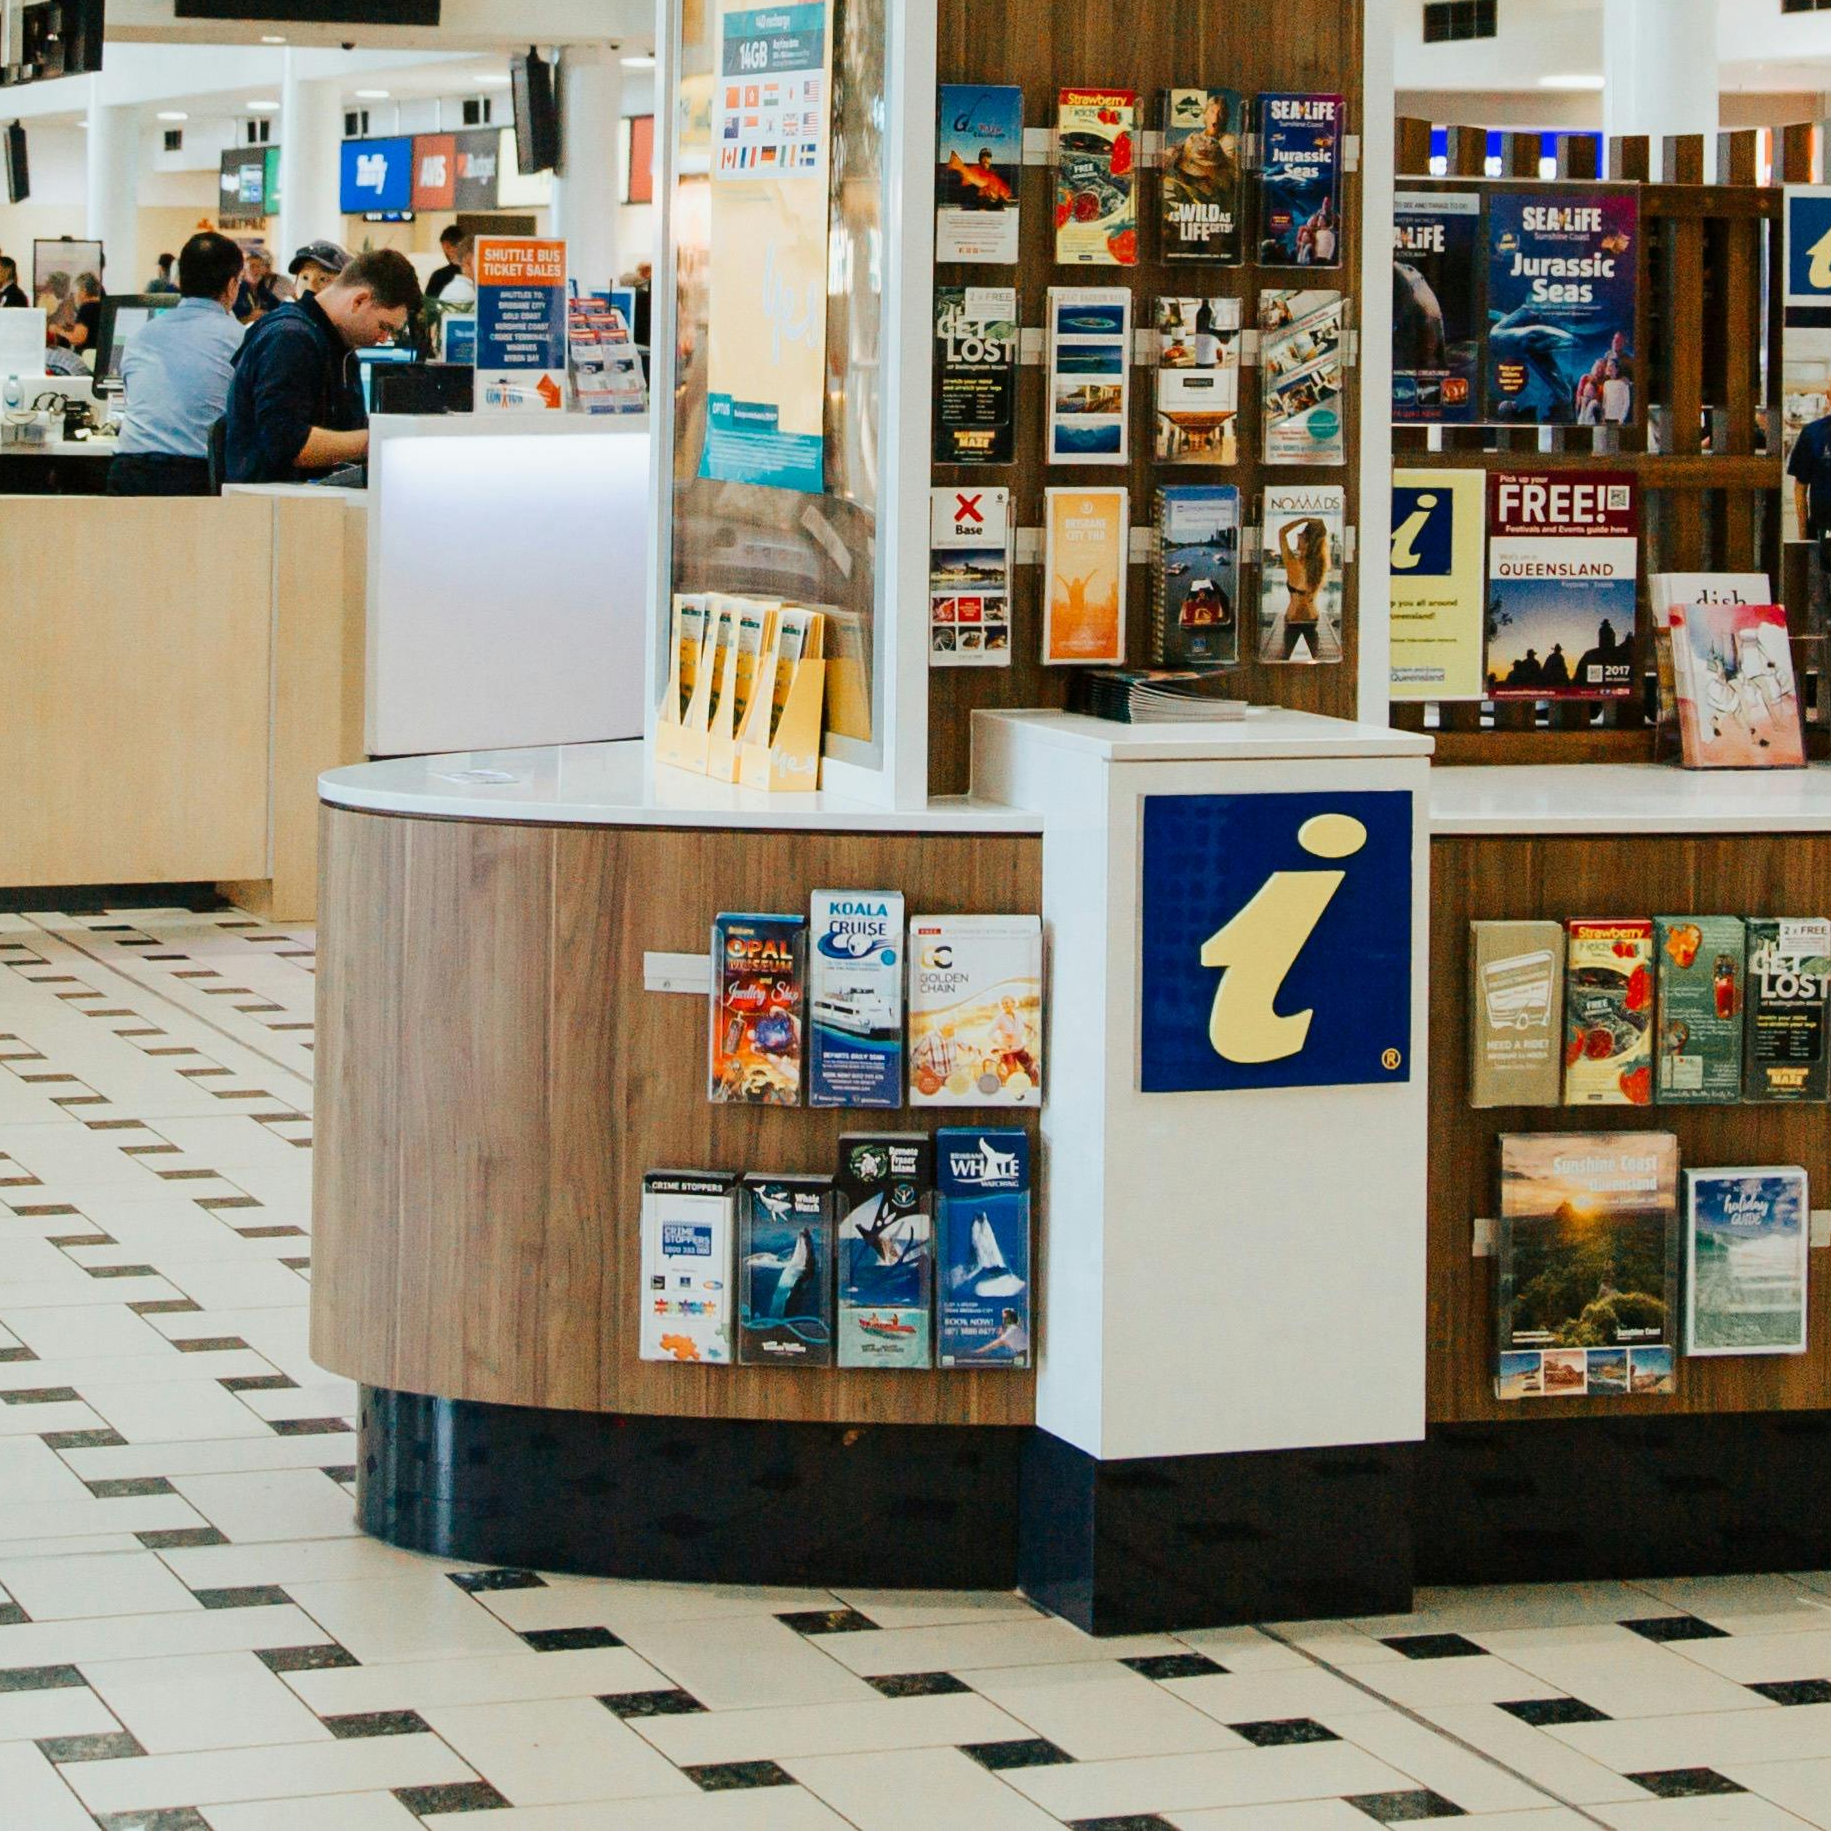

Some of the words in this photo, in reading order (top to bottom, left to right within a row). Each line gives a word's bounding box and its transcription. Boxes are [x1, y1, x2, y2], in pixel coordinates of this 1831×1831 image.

[739, 39, 769, 70] 14GB
[1066, 92, 1128, 108] Strawberry
[1271, 100, 1300, 121] SEA
[1271, 146, 1332, 164] Jurassic
[1284, 161, 1319, 179] Seas
[1179, 203, 1220, 223] WILD
[1522, 206, 1560, 232] SEA
[1180, 220, 1211, 242] LIFE
[484, 248, 534, 262] SHUTTLE
[537, 249, 561, 262] BUS
[483, 264, 523, 277] TICKET
[526, 264, 562, 277] SALES
[1510, 252, 1616, 279] Jurassic
[1531, 278, 1593, 304] Seas
[946, 337, 1017, 363] LOST
[1531, 476, 1549, 485] your
[1270, 495, 1341, 511] NOMADS
[1498, 484, 1607, 524] FREE!
[955, 524, 983, 537] Base
[1505, 525, 1541, 534] Festivals
[1542, 525, 1557, 533] and
[1558, 525, 1585, 534] Events
[1586, 526, 1610, 535] guide
[1610, 526, 1629, 534] here
[1499, 563, 1615, 577] QUEENSLAND
[1426, 598, 1458, 608] around
[1605, 665, 1631, 676] 2017
[829, 901, 888, 918] KOALA
[829, 920, 887, 937] CRUISE
[1577, 926, 1645, 940] Strawberry
[1800, 925, 1829, 936] FREE
[726, 937, 794, 960] OPAL
[920, 973, 969, 983] GOLDEN
[920, 983, 956, 994] CHAIN
[1552, 1156, 1616, 1176] Sunshine
[1620, 1154, 1659, 1172] Coast
[651, 1180, 680, 1191] CRIME
[681, 1182, 723, 1193] STOPPERS
[1588, 1175, 1658, 1194] Queensland
[794, 1193, 821, 1204] Whale
[1723, 1193, 1770, 1218] holiday
[794, 1202, 821, 1213] Watch
[1730, 1213, 1763, 1227] GUIDE
[664, 1226, 695, 1237] CRIME
[664, 1234, 711, 1246] STOPPERS
